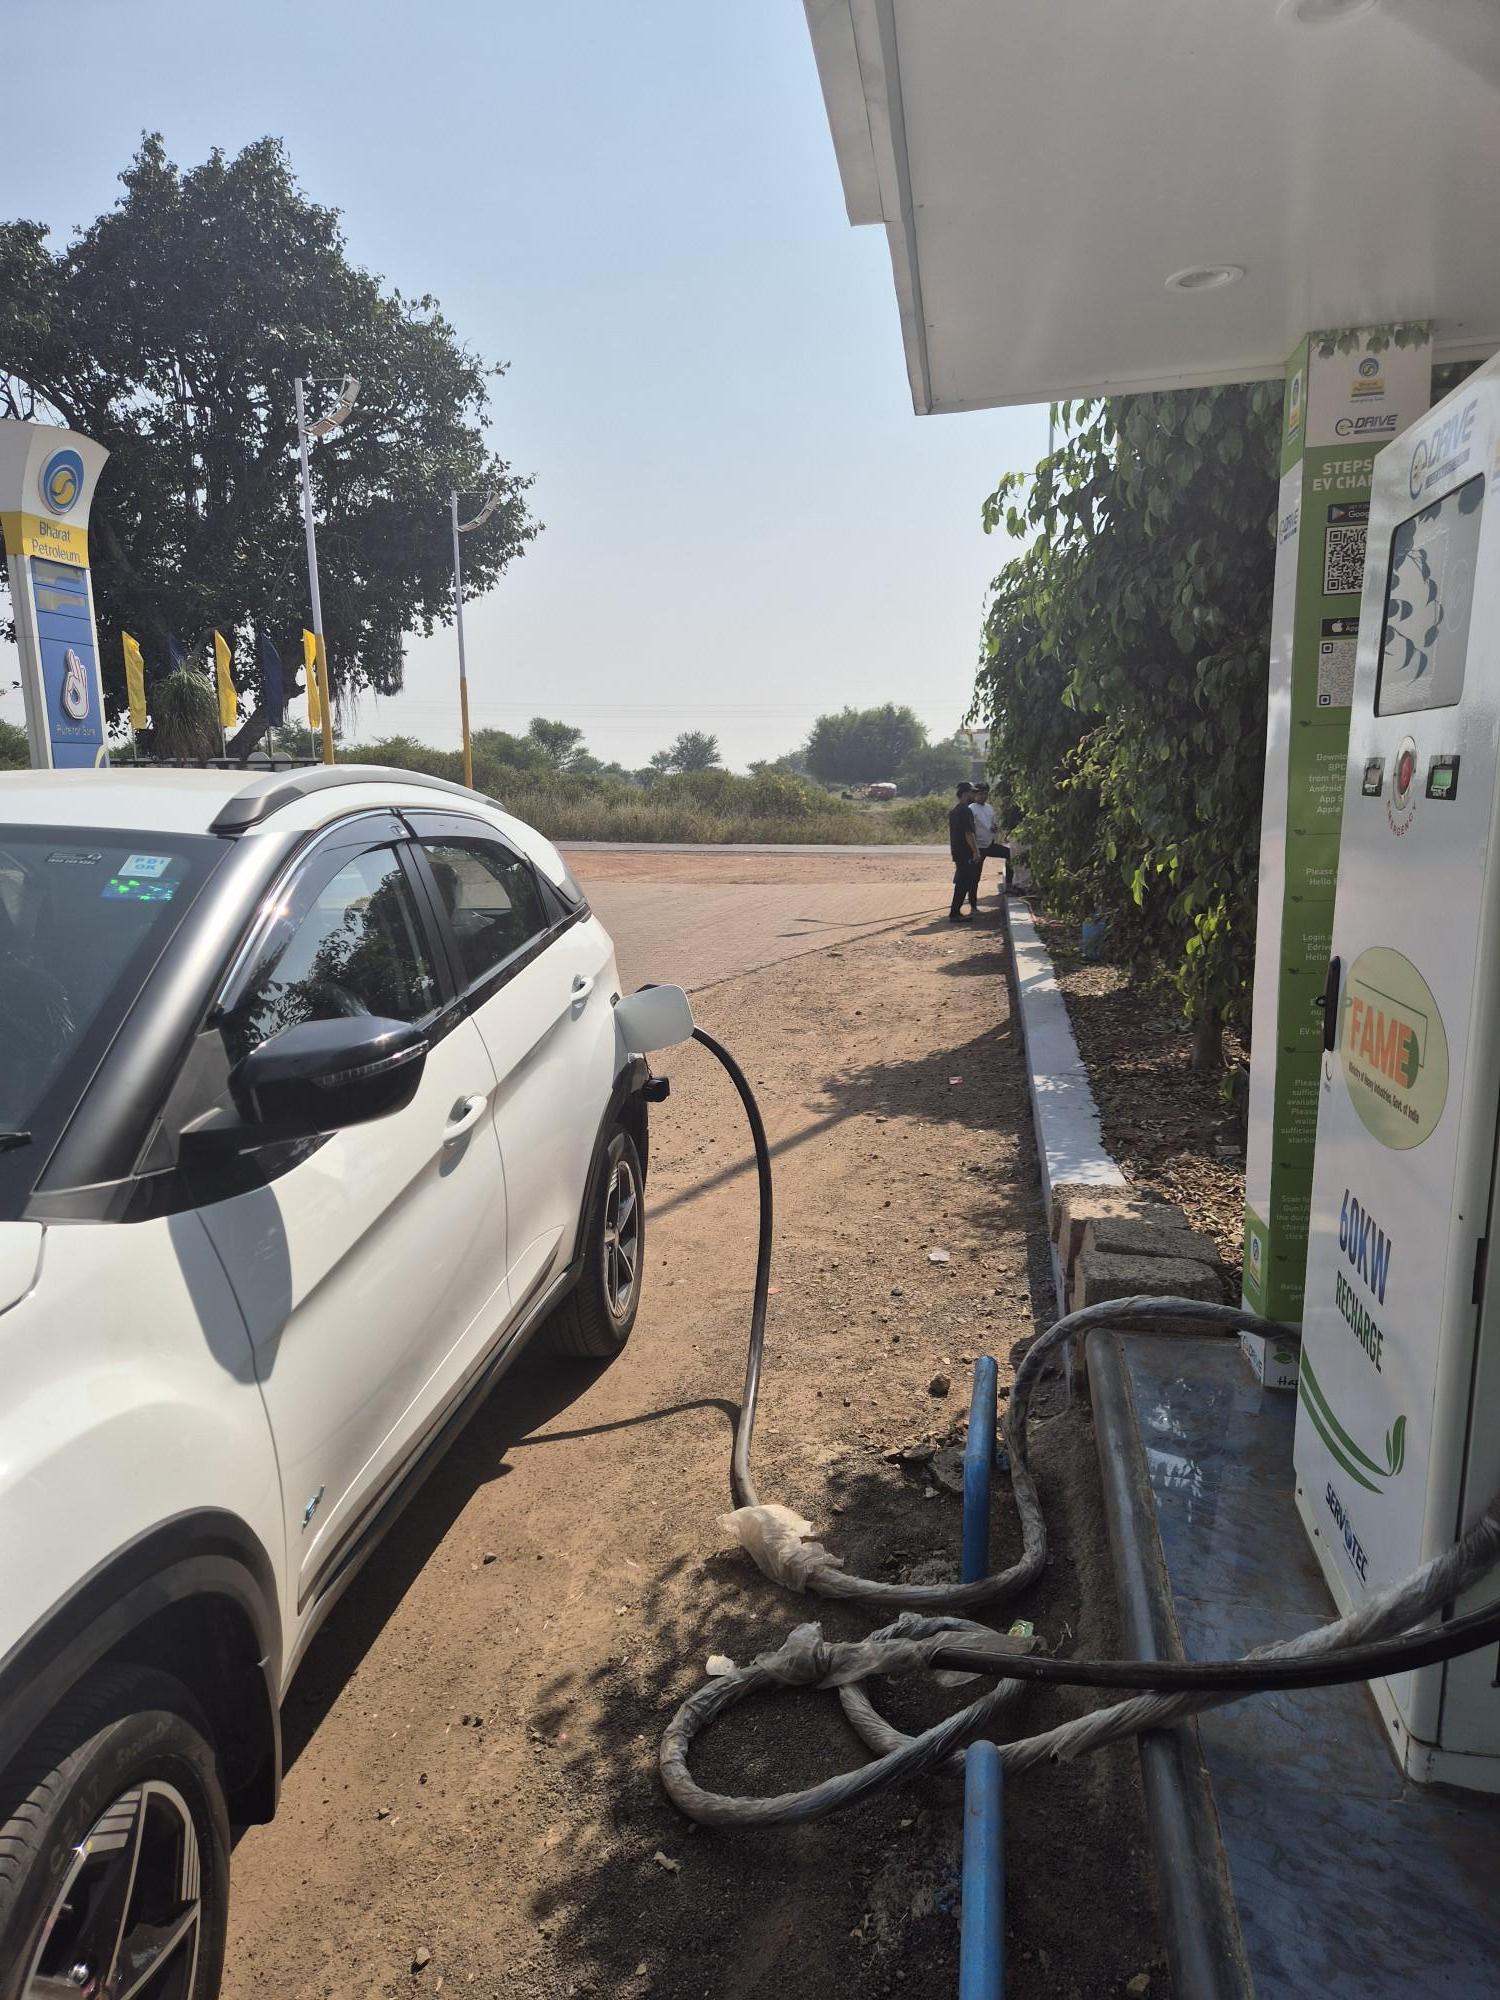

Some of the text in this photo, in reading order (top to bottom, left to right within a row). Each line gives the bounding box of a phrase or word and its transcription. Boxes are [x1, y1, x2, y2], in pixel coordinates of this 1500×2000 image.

[1322, 459, 1373, 476] STEPS
[1312, 478, 1333, 492] EV
[39, 521, 72, 543] Bharat
[31, 538, 82, 563] Petroleum
[1351, 996, 1413, 1089] FAME
[1339, 1188, 1392, 1306] 60KW
[1335, 1269, 1384, 1374] RECHARGE
